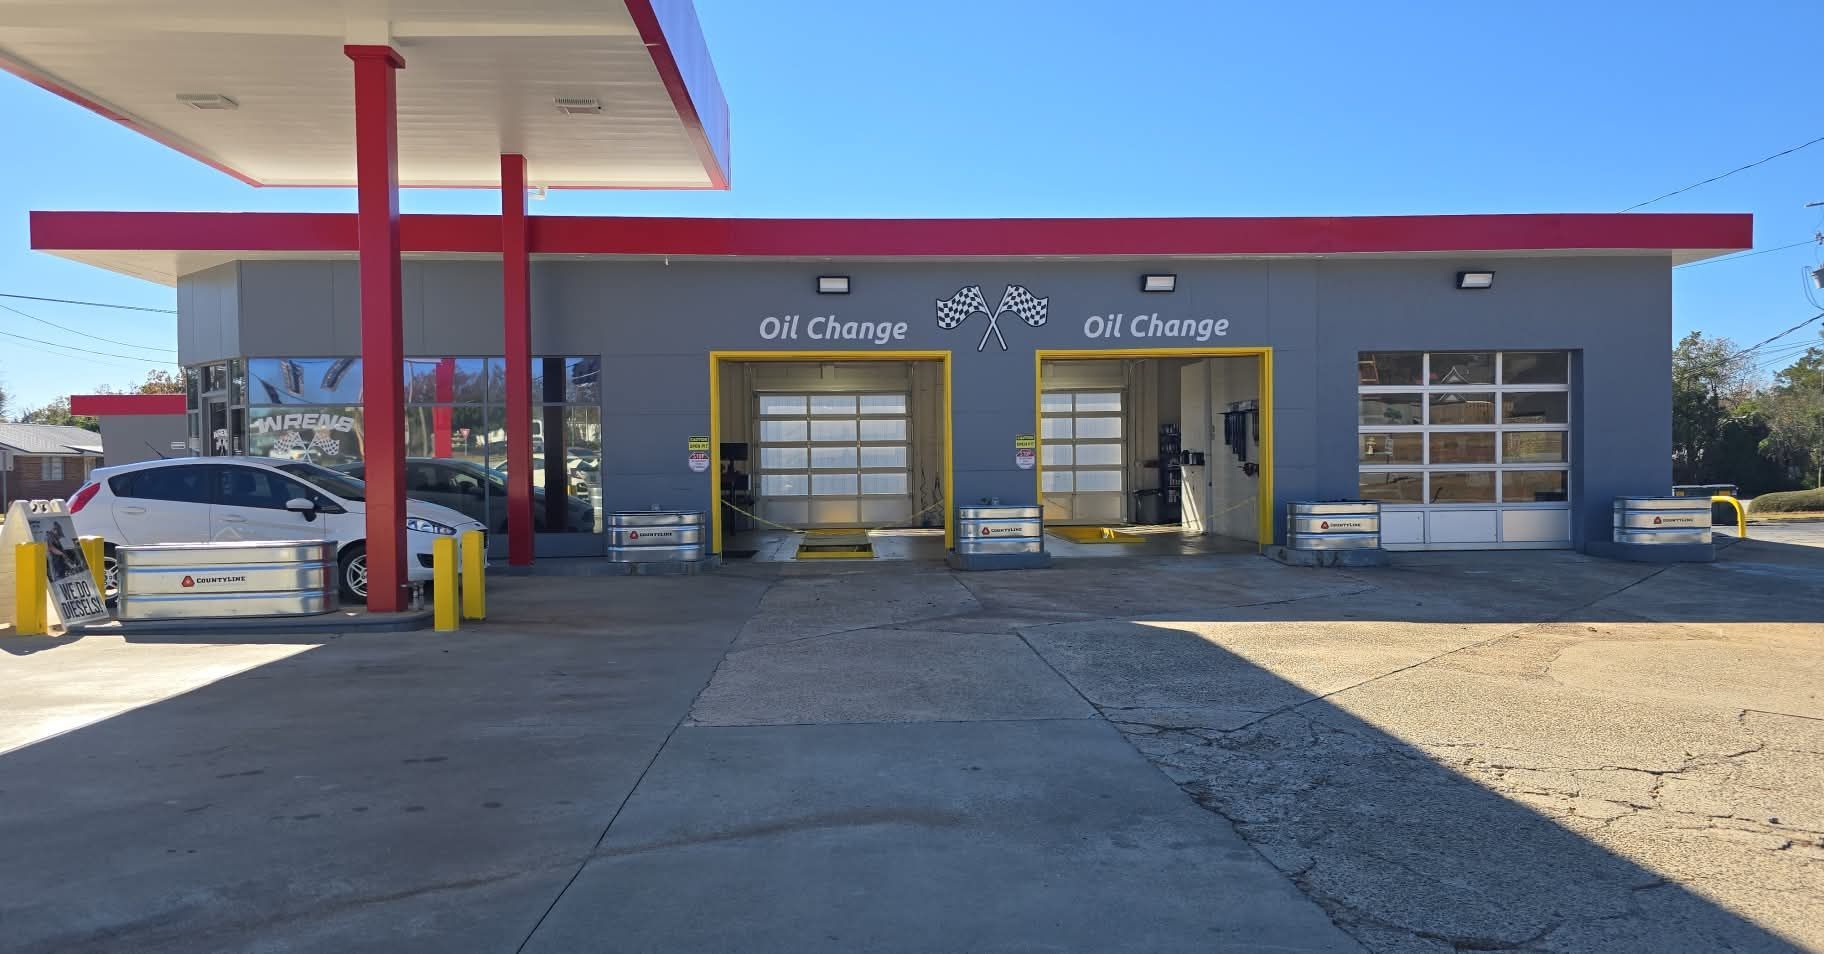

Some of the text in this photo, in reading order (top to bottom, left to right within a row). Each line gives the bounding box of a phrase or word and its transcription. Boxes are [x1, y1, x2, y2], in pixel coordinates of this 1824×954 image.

[759, 315, 908, 345] Oil Change
[1083, 313, 1230, 342] Oil Change
[257, 413, 354, 433] WRENS
[59, 580, 91, 600] WE DO
[61, 598, 104, 620] DIESELS!
